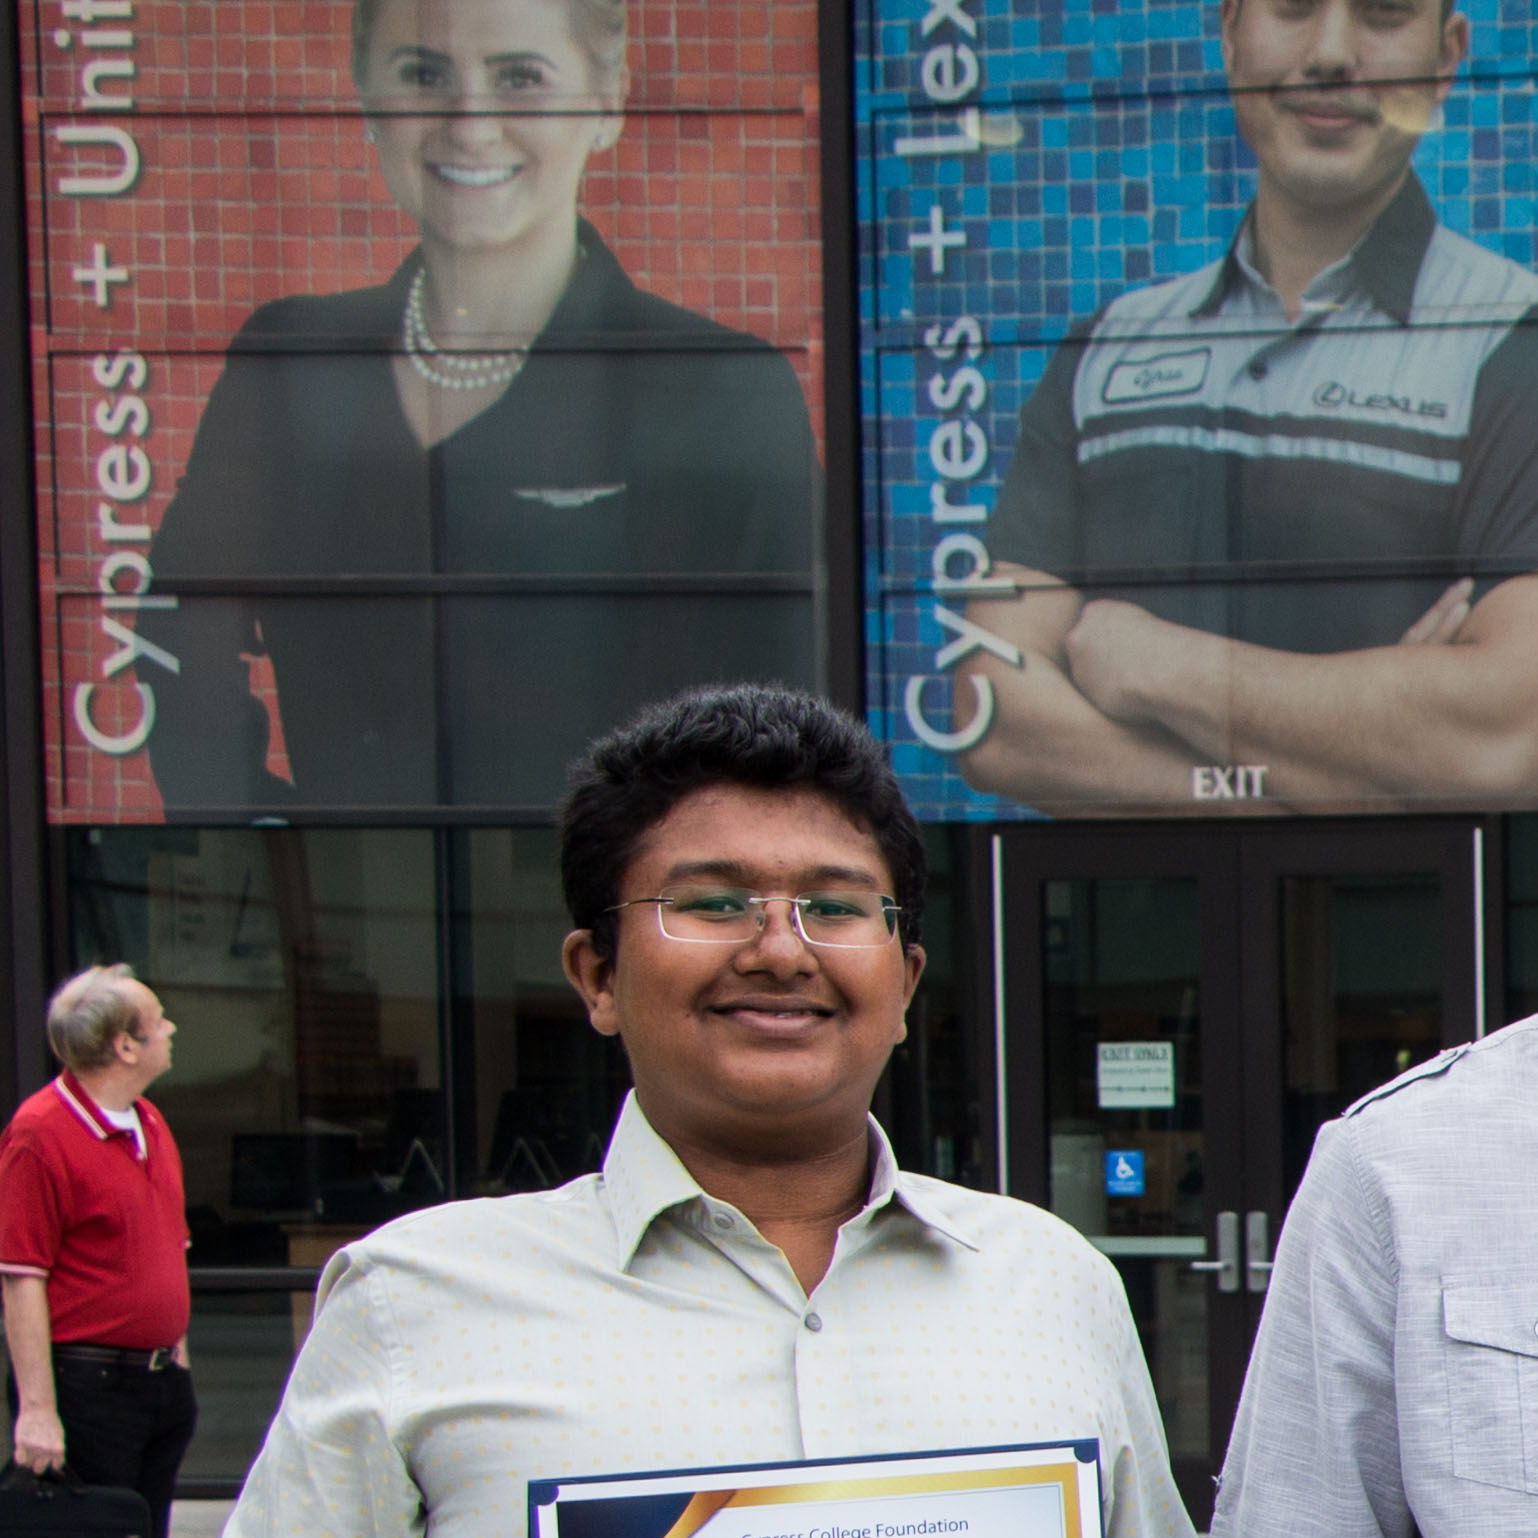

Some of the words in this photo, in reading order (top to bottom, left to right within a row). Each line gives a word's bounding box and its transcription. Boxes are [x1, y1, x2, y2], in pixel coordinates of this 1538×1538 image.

[1349, 394, 1447, 418] LEXUS
[74, 348, 181, 756] Cypress
[904, 316, 1022, 752] Cypress
[1192, 765, 1269, 801] EXIT
[875, 1518, 969, 1538] Foundation
